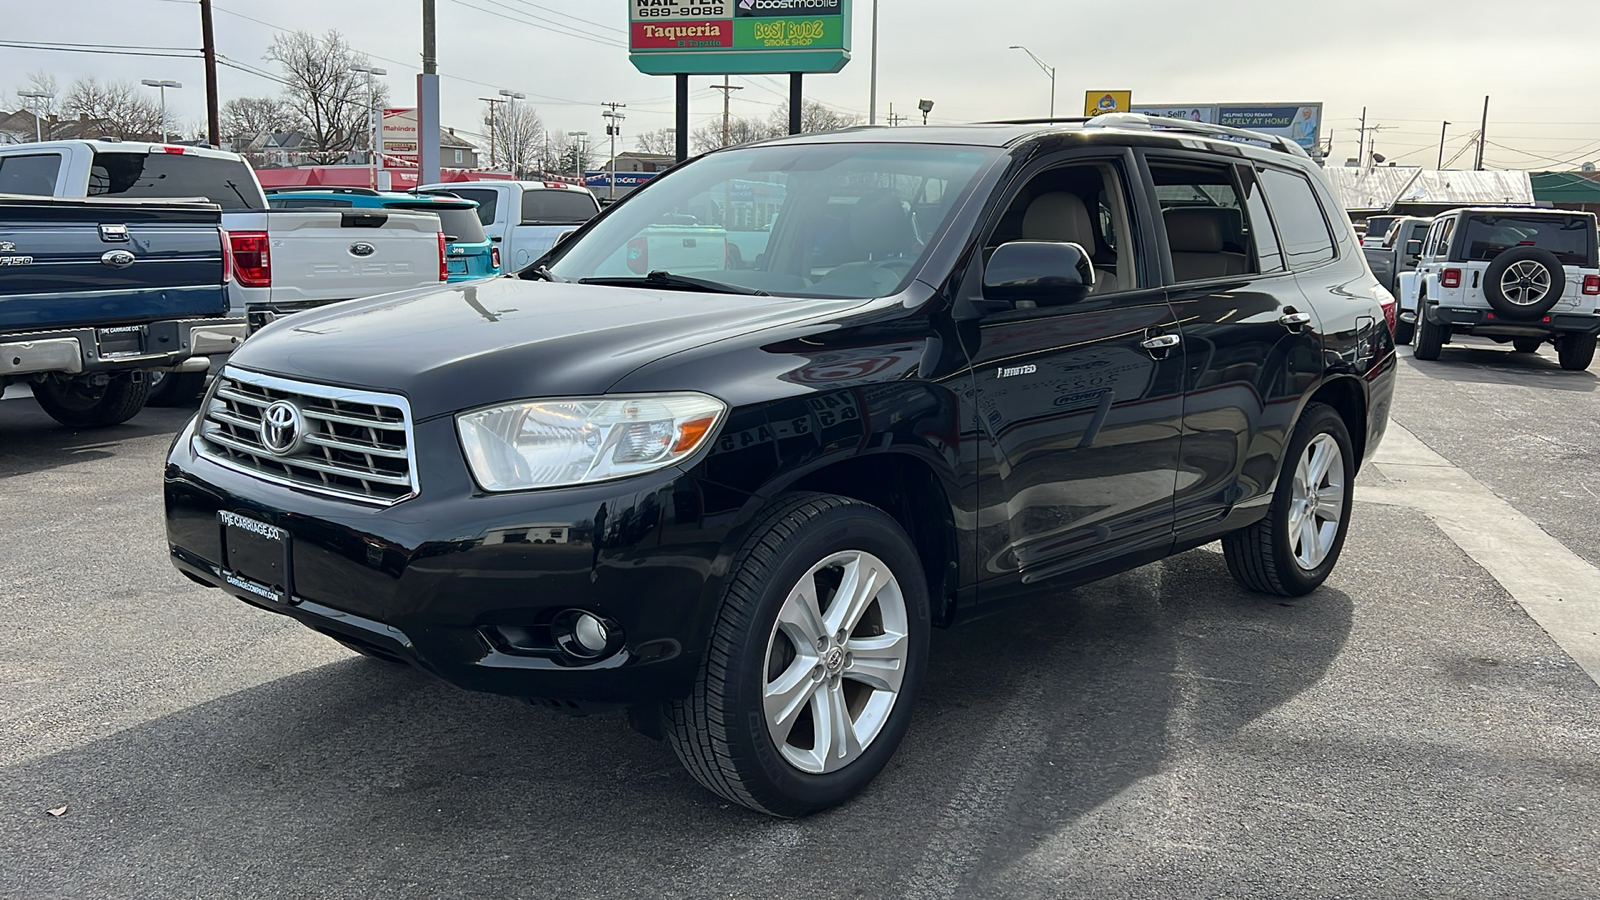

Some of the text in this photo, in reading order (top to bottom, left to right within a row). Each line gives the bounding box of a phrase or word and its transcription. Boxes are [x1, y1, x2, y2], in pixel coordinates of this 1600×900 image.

[639, 6, 724, 17] 689-9088
[791, 38, 813, 46] SHOP
[1167, 110, 1187, 118] Sell?
[306, 261, 414, 277] F-150
[221, 512, 235, 526] THE
[234, 516, 268, 538] CARRIAGE
[226, 576, 279, 602] CARRIAGECOMPANY.COM
